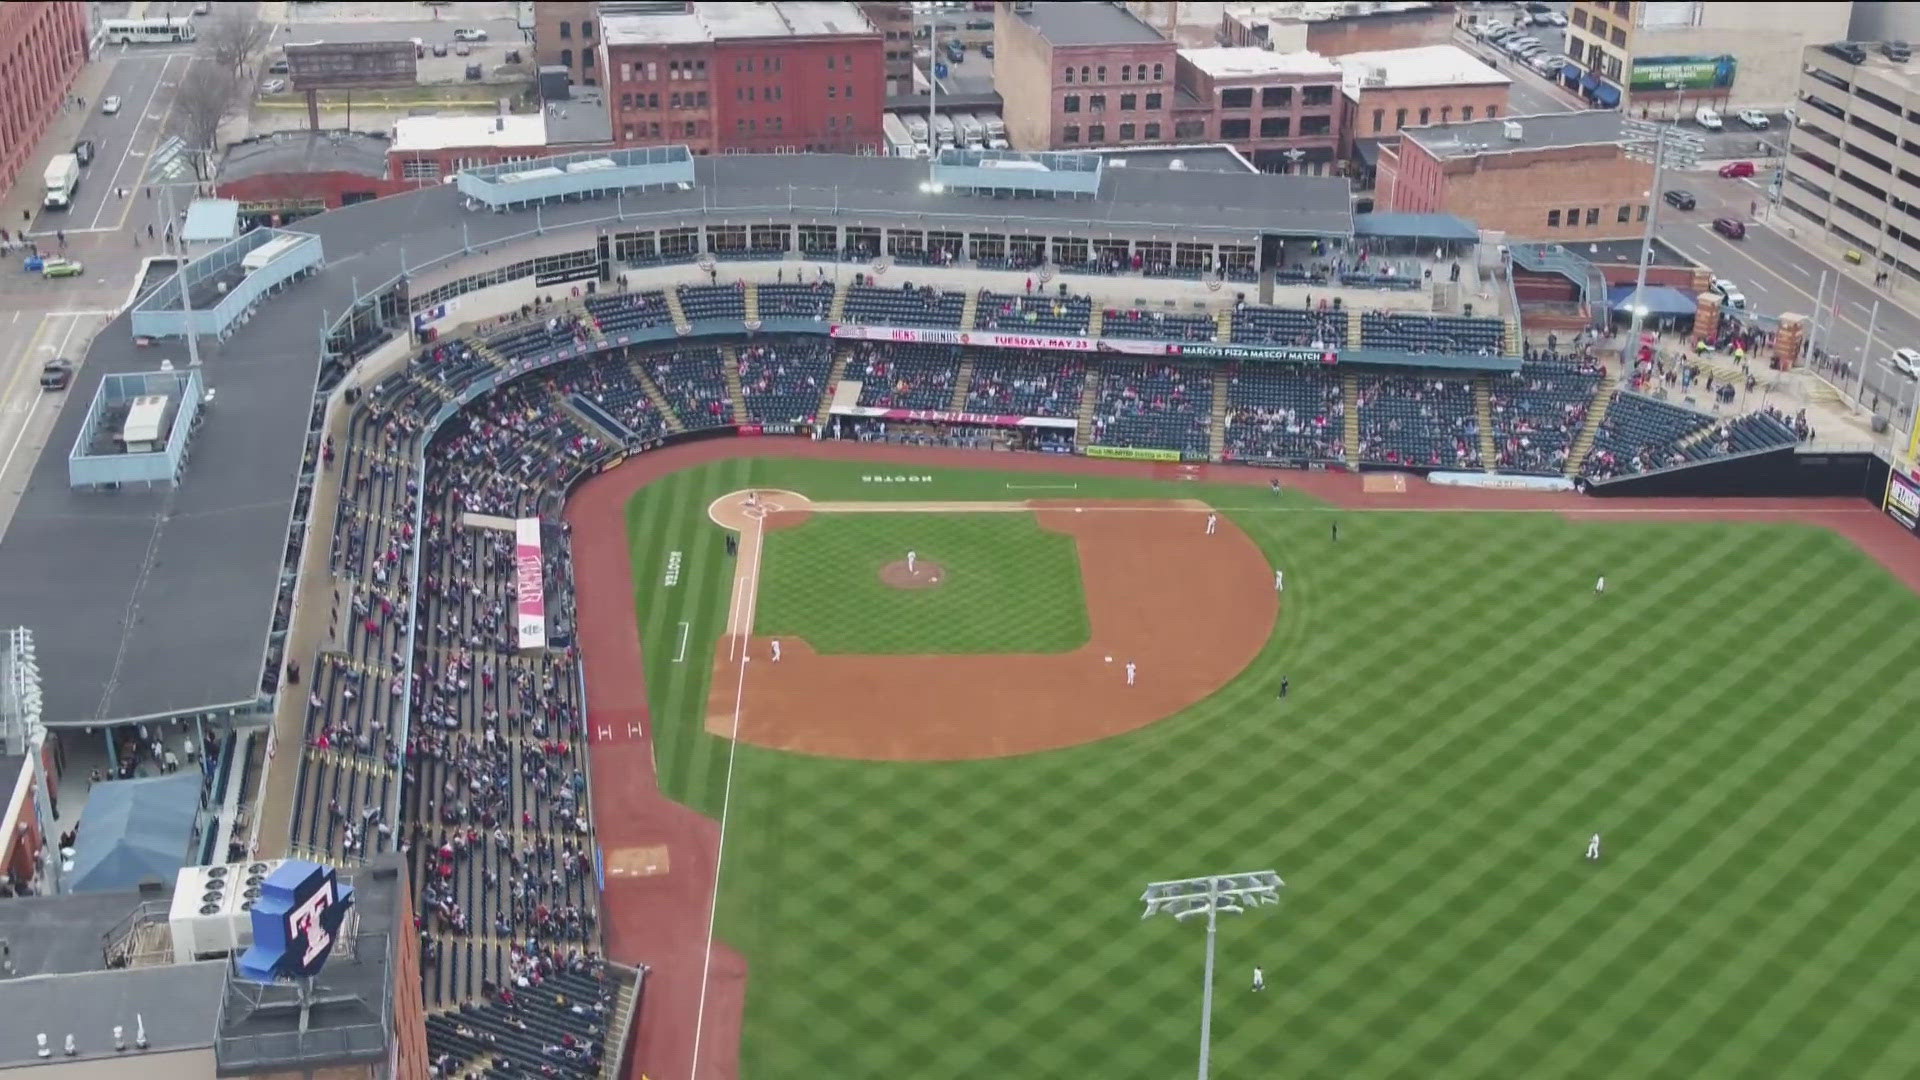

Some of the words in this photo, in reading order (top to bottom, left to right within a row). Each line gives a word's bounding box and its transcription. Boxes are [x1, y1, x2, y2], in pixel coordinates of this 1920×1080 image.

[994, 335, 1046, 347] TUESDAY,
[1049, 339, 1071, 348] MAY
[1076, 341, 1088, 349] 23
[1183, 346, 1223, 356] MARCO'S
[1224, 349, 1249, 358] PIZZA
[1250, 350, 1288, 359] MASCOT
[1289, 352, 1321, 361] MATCH
